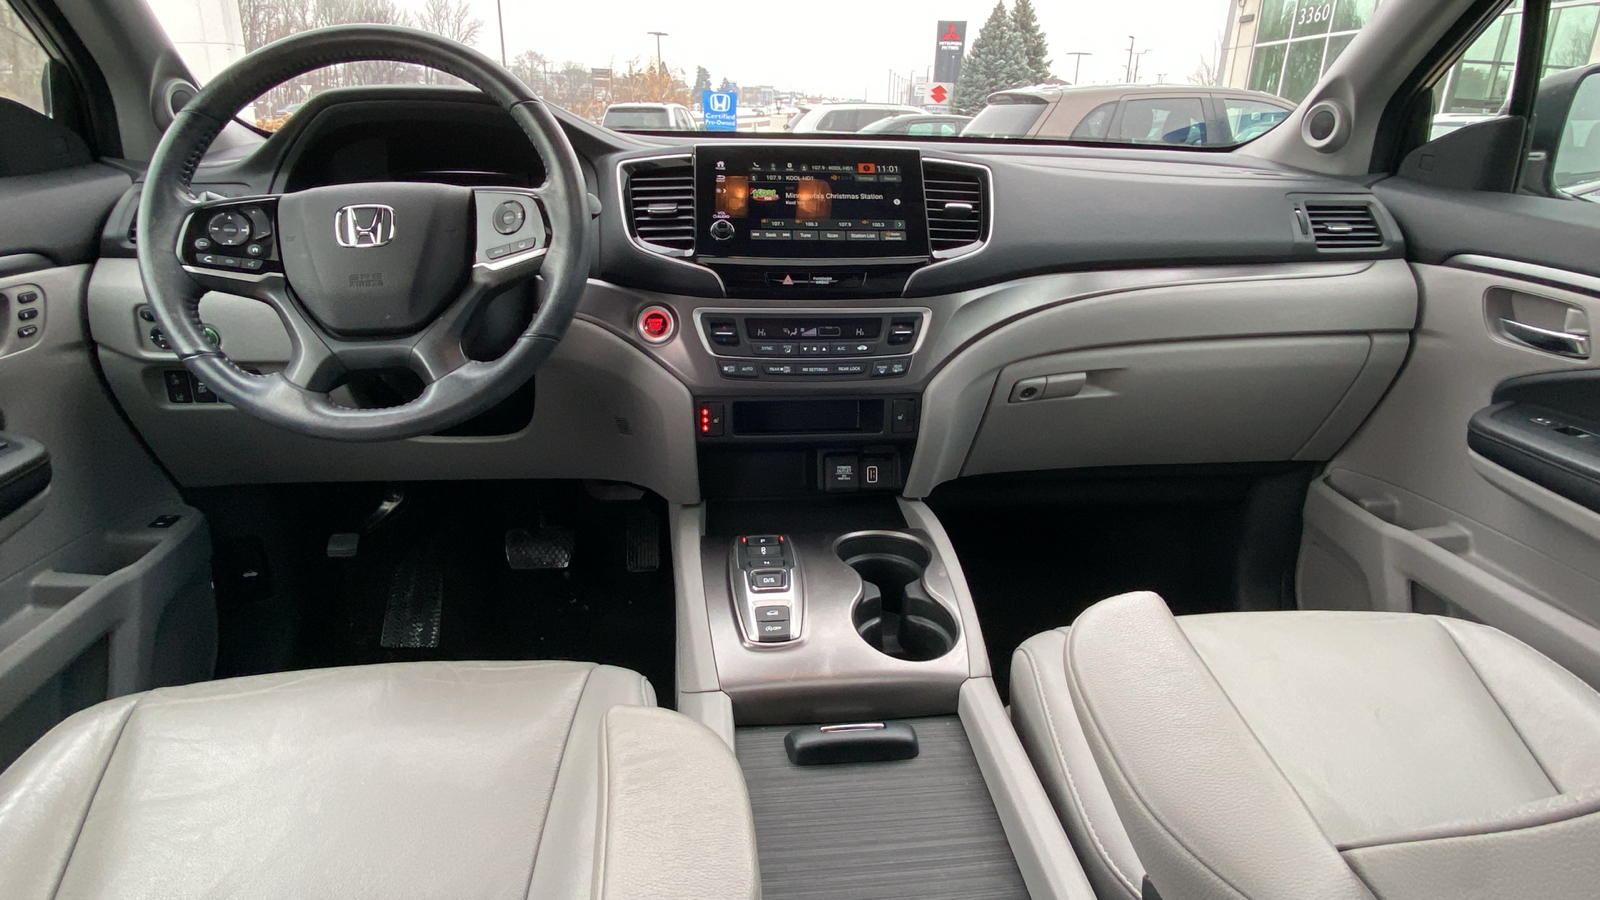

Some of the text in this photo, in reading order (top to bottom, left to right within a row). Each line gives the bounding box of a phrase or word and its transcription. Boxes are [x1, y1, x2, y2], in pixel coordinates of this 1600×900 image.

[1298, 3, 1331, 25] 3360
[705, 112, 736, 120] Certified
[876, 165, 899, 173] 11:01
[825, 192, 859, 200] Christmas
